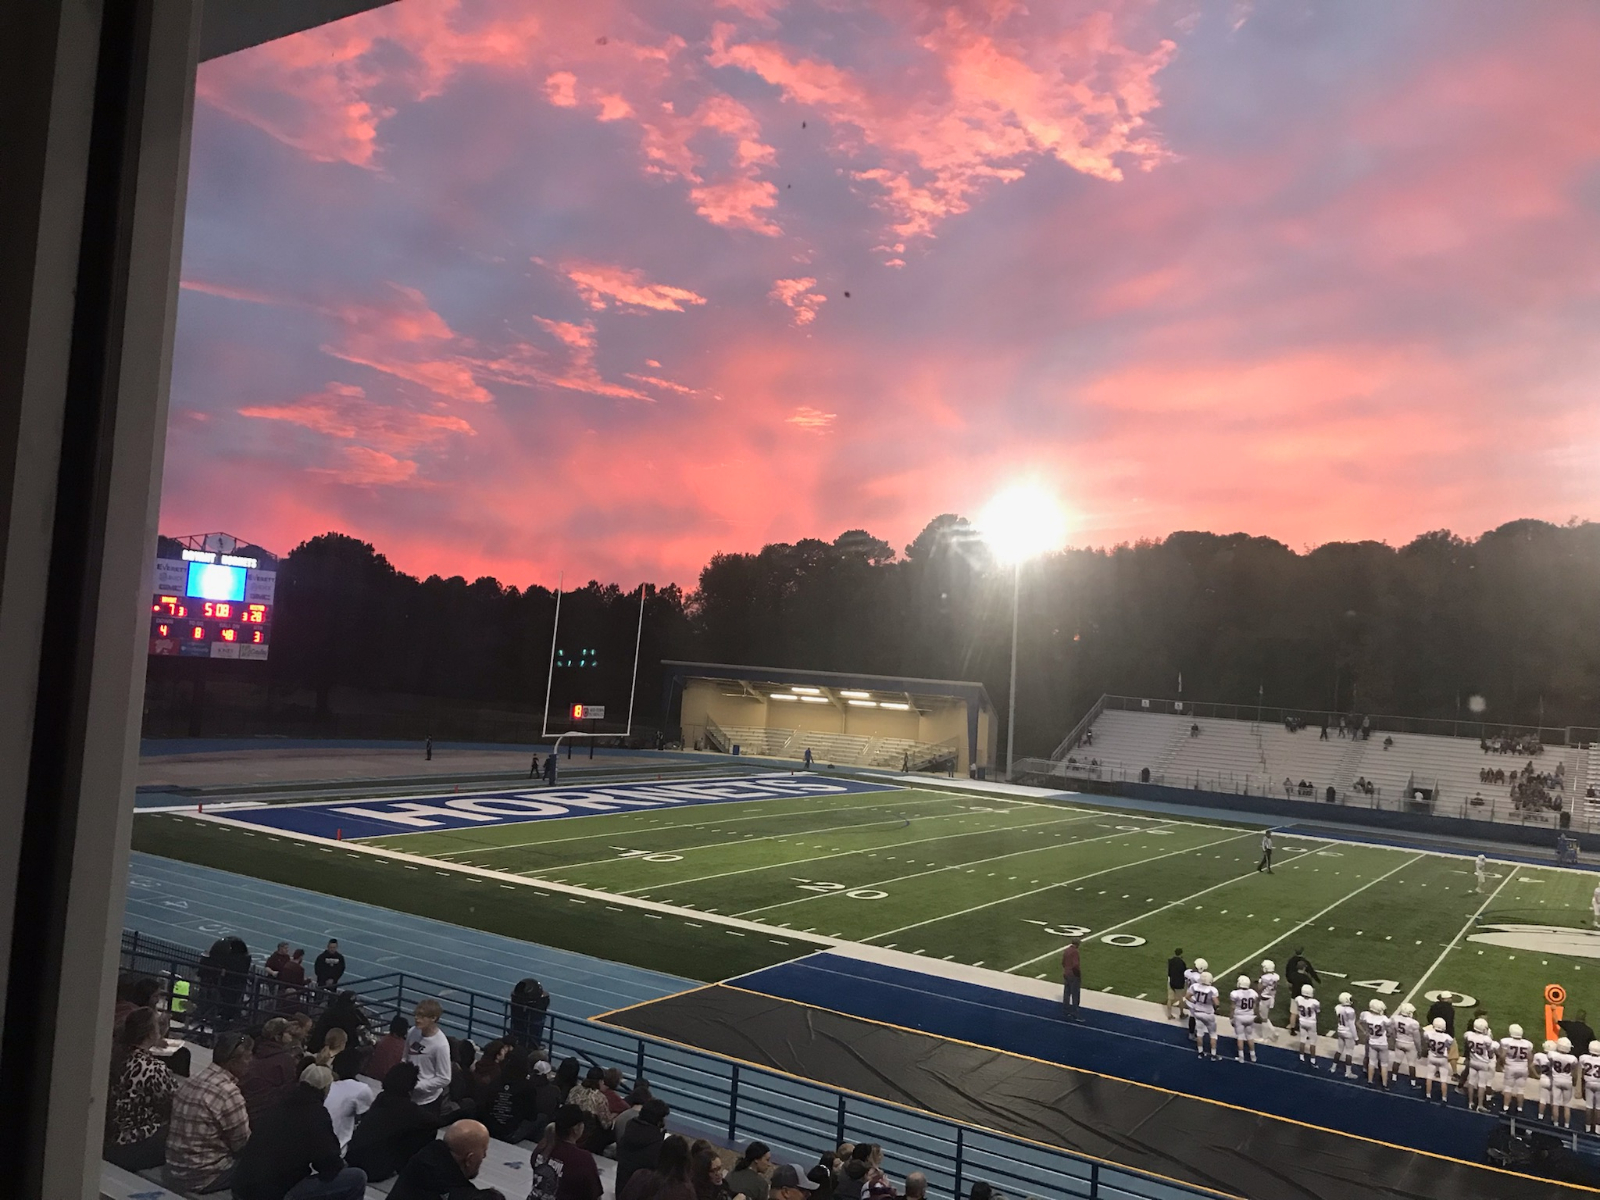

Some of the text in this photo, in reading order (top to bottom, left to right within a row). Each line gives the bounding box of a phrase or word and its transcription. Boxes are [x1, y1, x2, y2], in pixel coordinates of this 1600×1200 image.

[159, 625, 168, 636] 4
[328, 779, 849, 828] HORNETS
[1044, 924, 1147, 947] 30
[1241, 997, 1255, 1010] 60
[1398, 1022, 1406, 1035] 5
[1509, 1045, 1528, 1060] 75
[1553, 1060, 1572, 1075] 84
